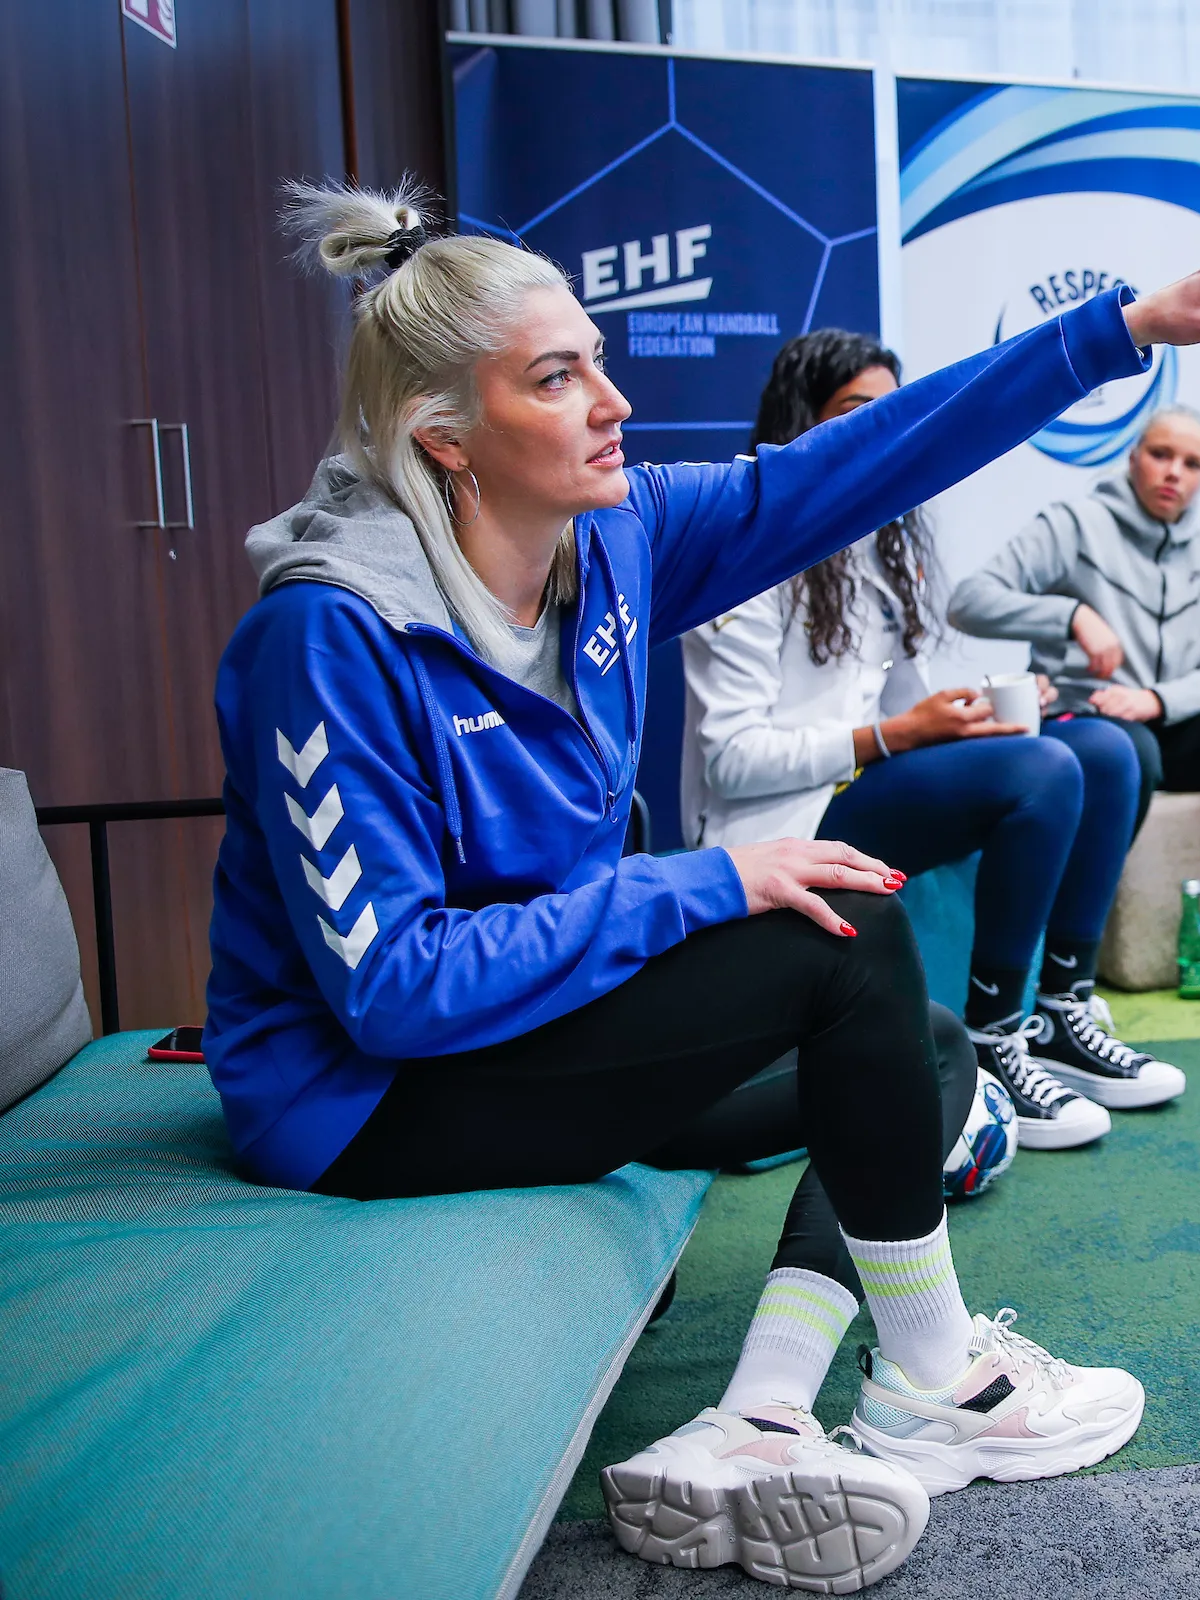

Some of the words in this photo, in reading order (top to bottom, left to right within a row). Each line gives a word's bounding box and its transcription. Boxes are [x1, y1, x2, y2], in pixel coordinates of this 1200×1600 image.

[581, 224, 712, 300] EHF
[1029, 269, 1139, 314] RESPE
[627, 312, 703, 334] EUROPEAN
[705, 312, 780, 335] HANDBALL
[629, 335, 716, 357] FEDERATION
[583, 593, 630, 667] EHF
